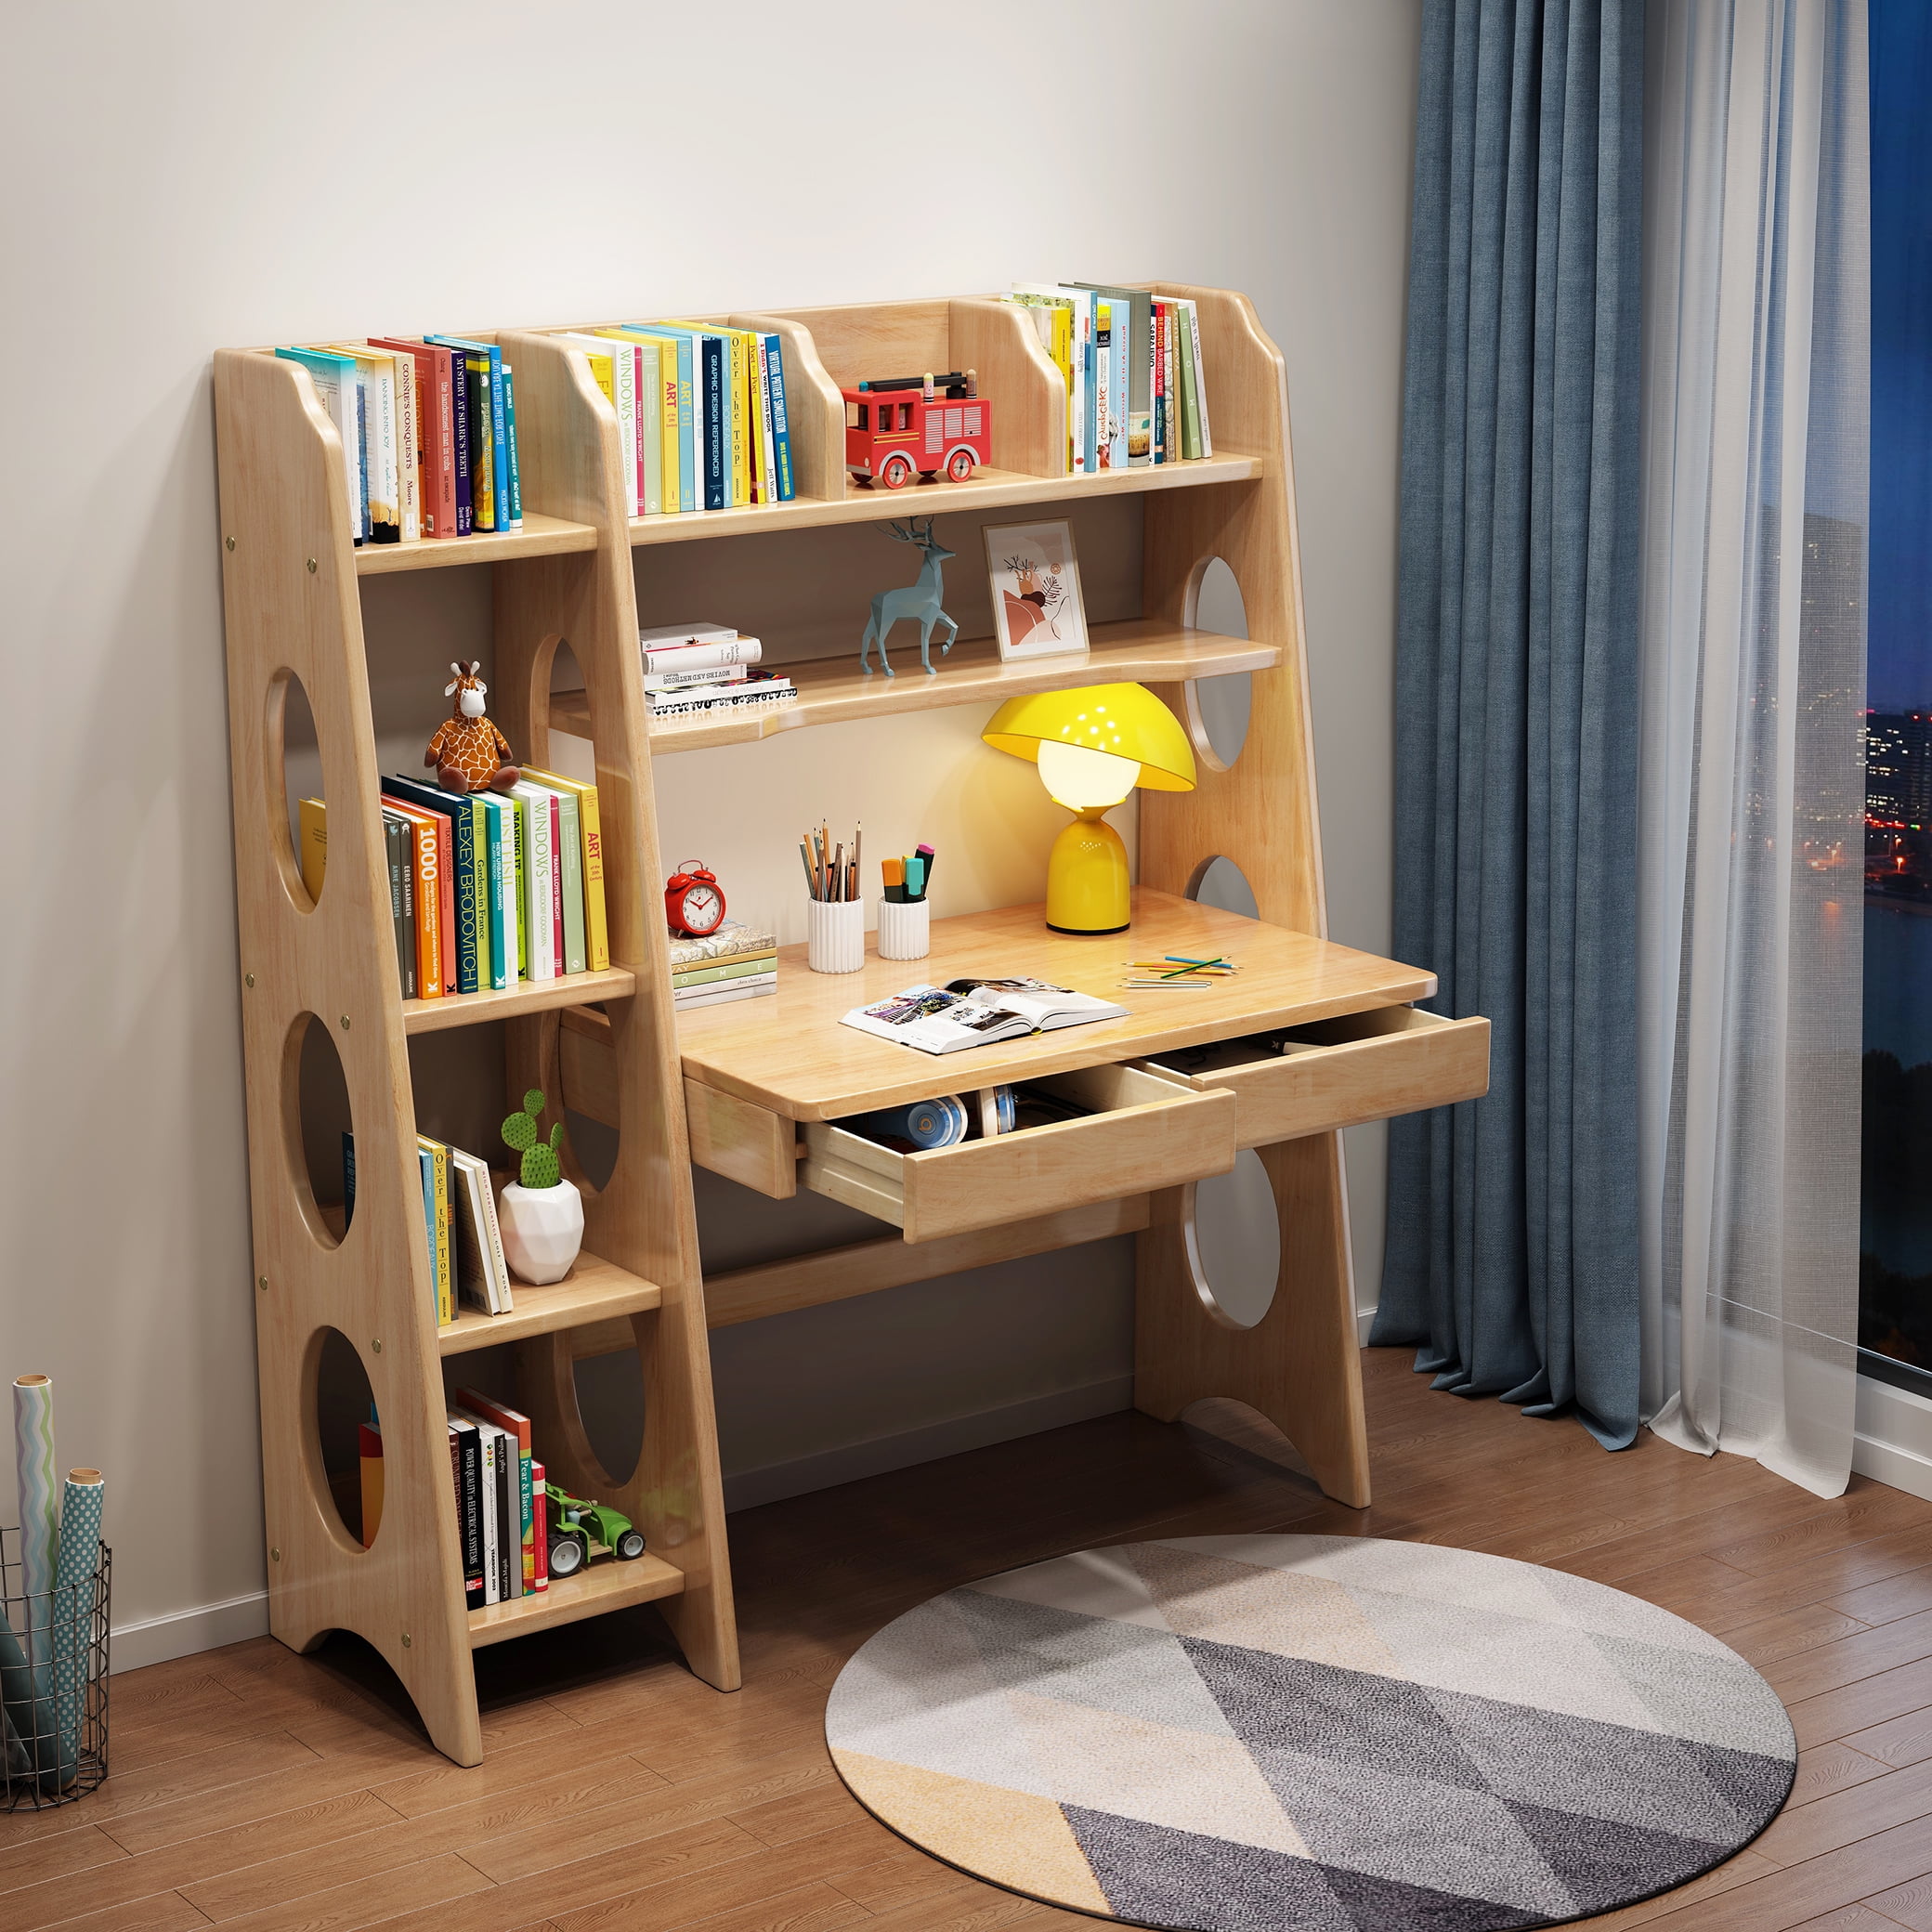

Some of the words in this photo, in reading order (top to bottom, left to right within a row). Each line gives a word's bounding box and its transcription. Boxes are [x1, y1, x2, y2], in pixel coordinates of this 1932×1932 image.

[769, 350, 781, 376] VIRTUAL
[402, 364, 411, 409] CONNIE'S
[456, 359, 465, 398] MYSTERY
[620, 349, 633, 420] WINDOWS
[771, 376, 783, 399] PATIENT
[458, 400, 465, 411] AT
[666, 381, 677, 408] ART
[681, 380, 691, 407] ART
[773, 399, 786, 434] SIMULATION
[404, 411, 412, 470] CONQUESTS
[663, 676, 692, 685] METHODS
[706, 670, 731, 679] MOVIES
[458, 806, 473, 869] ALEXEY
[535, 801, 549, 878] WINDOWS
[587, 832, 600, 859] ART
[420, 828, 437, 881] 1000
[515, 859, 521, 870] IT
[478, 899, 485, 907] in
[460, 874, 477, 981] BRODOVITCH
[435, 1153, 444, 1195] Over
[465, 1448, 474, 1469] POWER
[521, 1460, 529, 1481] Pear
[465, 1469, 476, 1495] QUALITY
[467, 1501, 477, 1536] ELECTRICAL
[469, 1537, 478, 1565] SYSTEMS
